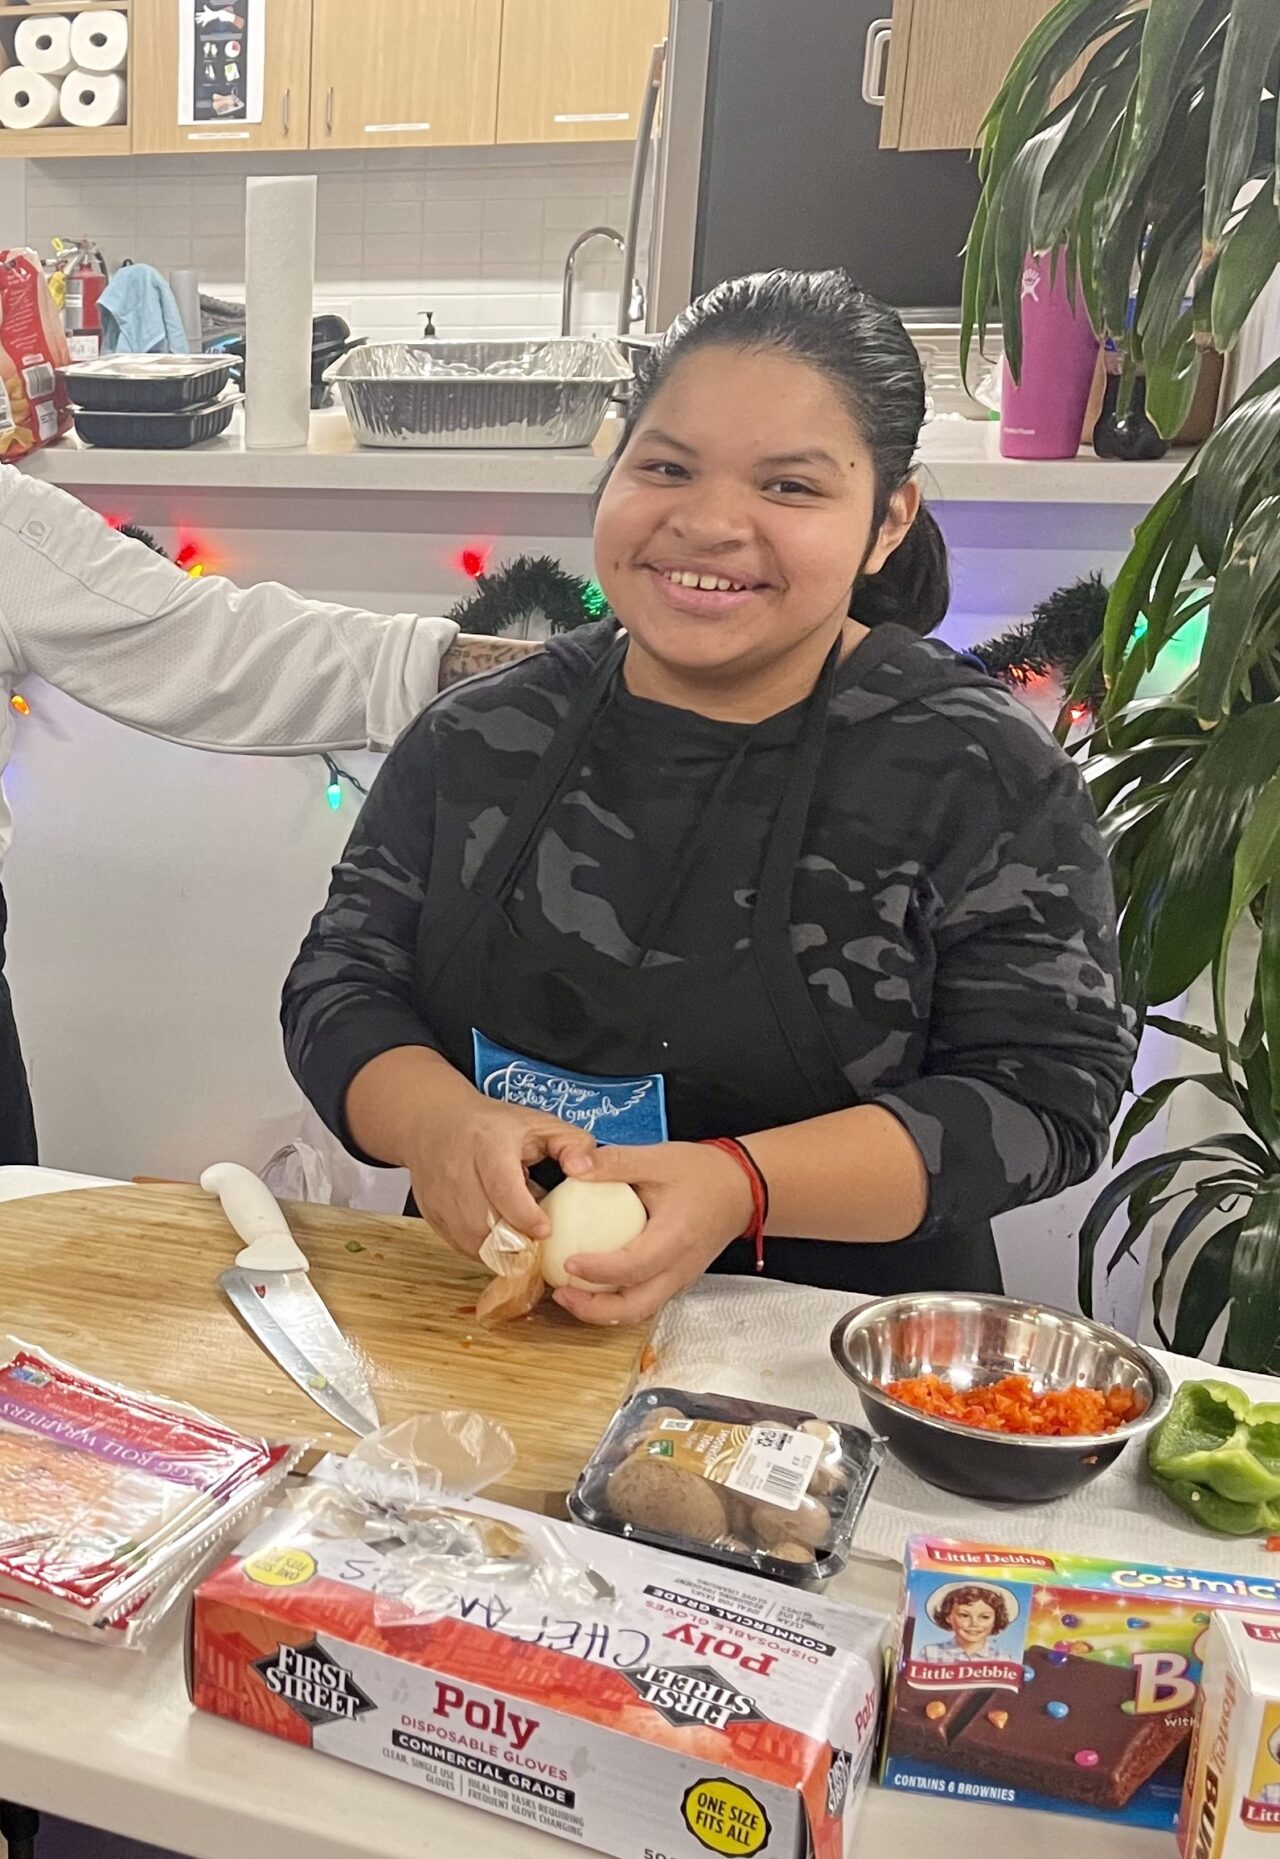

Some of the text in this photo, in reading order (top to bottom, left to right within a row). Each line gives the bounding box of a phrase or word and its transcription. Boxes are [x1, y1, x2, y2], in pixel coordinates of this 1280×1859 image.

[547, 1078, 600, 1102] Diego
[0, 1401, 98, 1448] WRAPPERS
[101, 1439, 154, 1468] ROLL
[933, 1550, 1047, 1567] Little Debbie
[1110, 1569, 1277, 1600] Cosmic
[644, 1599, 819, 1665] DISPOSABLE GLOVES
[652, 1587, 828, 1653] COMMERCIAL GRADE
[279, 1642, 352, 1695] FIRST
[662, 1622, 779, 1677] Poly
[910, 1664, 1018, 1681] Little Debbie
[266, 1666, 360, 1720] STREET
[636, 1664, 756, 1716] STREET
[638, 1684, 734, 1731] FIRST
[432, 1680, 540, 1752] Poly
[398, 1733, 566, 1803] COMMERCIAL GRADE
[401, 1714, 568, 1782] DISPOSABLE GLOVES
[411, 1757, 438, 1775] SINGLE
[440, 1767, 454, 1781] USE
[425, 1774, 455, 1793] GLOVES
[468, 1778, 585, 1829] IDEAL FOR TASKS REQUIRING
[894, 1773, 1016, 1802] CONTAINS 6 BROWNIES
[468, 1789, 584, 1839] FREQUENT GLOVE CHANGING
[695, 1810, 751, 1848] FITS ALL
[696, 1791, 761, 1832] ONE SIZE
[1247, 1805, 1280, 1823] Litt
